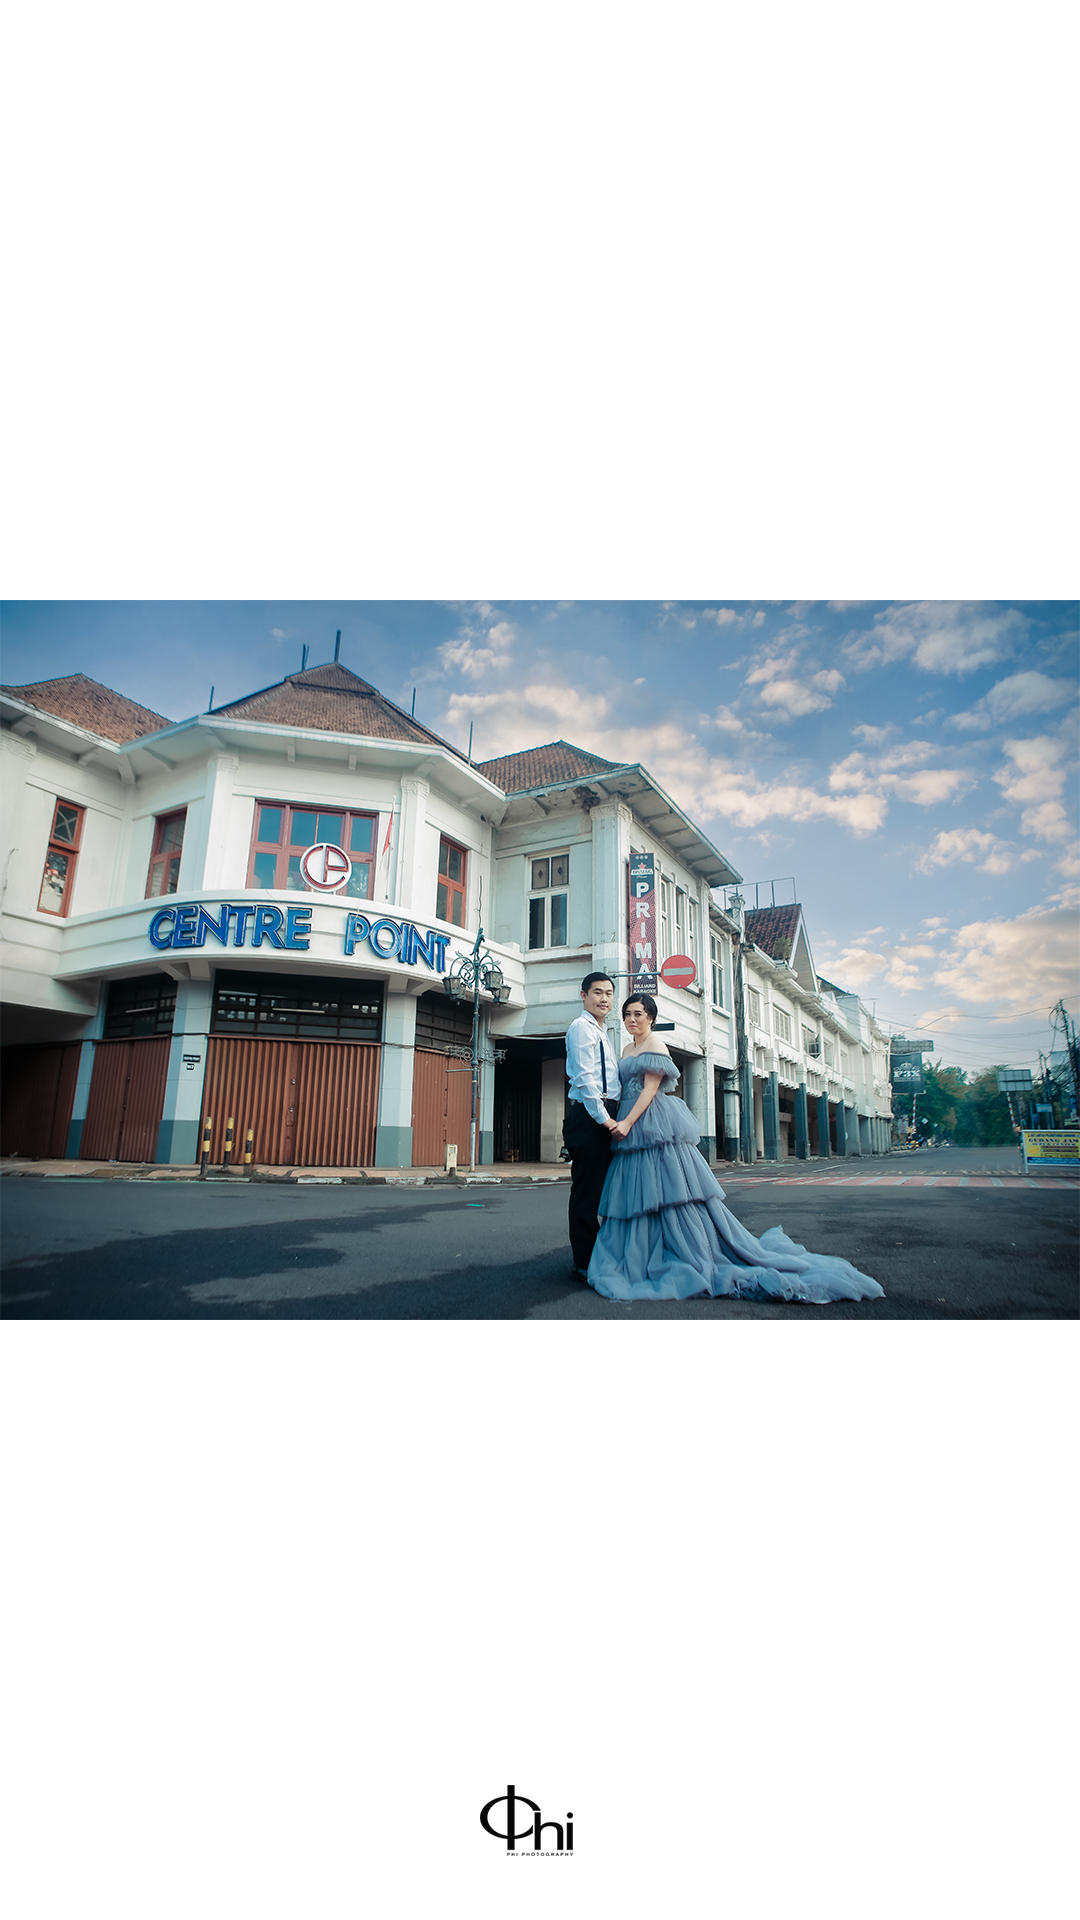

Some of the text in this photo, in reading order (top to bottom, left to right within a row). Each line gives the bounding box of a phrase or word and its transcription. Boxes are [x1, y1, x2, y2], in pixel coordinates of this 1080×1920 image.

[149, 904, 451, 973] CENTRE POINT
[635, 882, 653, 980] PRIMA
